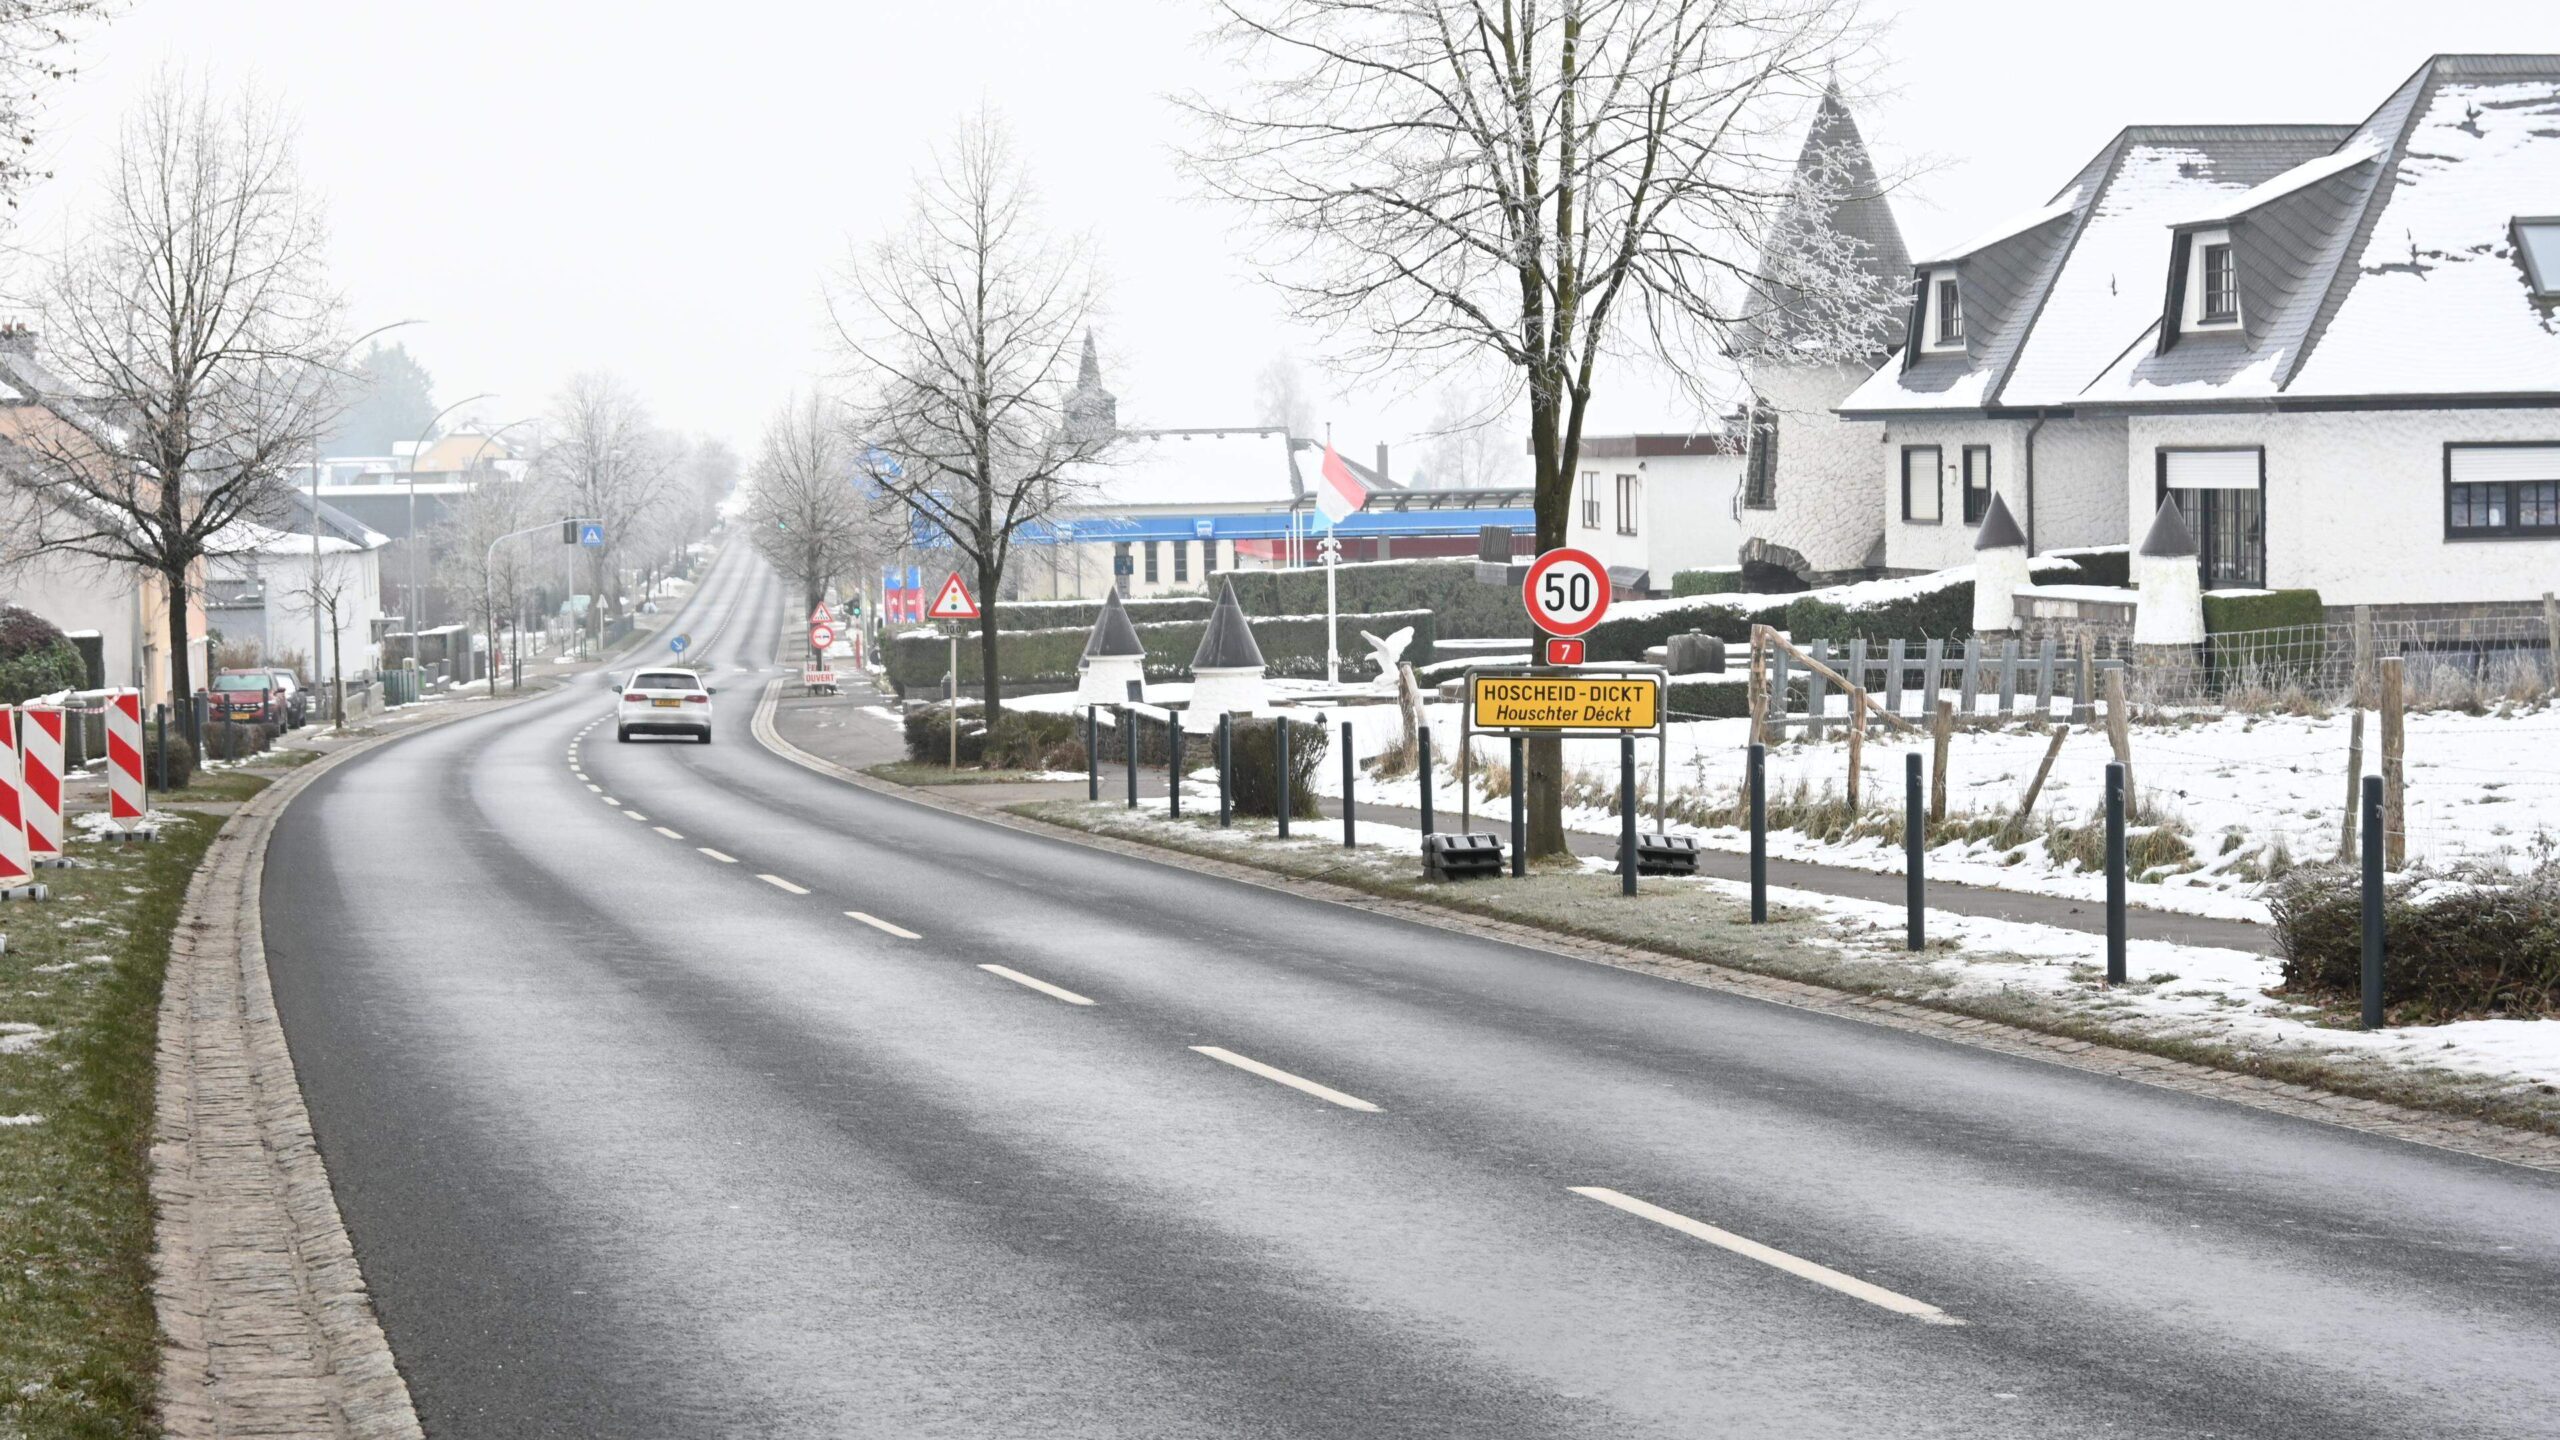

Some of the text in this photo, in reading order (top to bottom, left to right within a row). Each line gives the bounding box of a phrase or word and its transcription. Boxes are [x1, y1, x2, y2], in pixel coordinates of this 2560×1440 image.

[1545, 573, 1590, 611] 50
[1561, 644, 1571, 660] 7
[806, 674, 834, 682] OUVERT
[1496, 705, 1632, 721] Houschter Déckt
